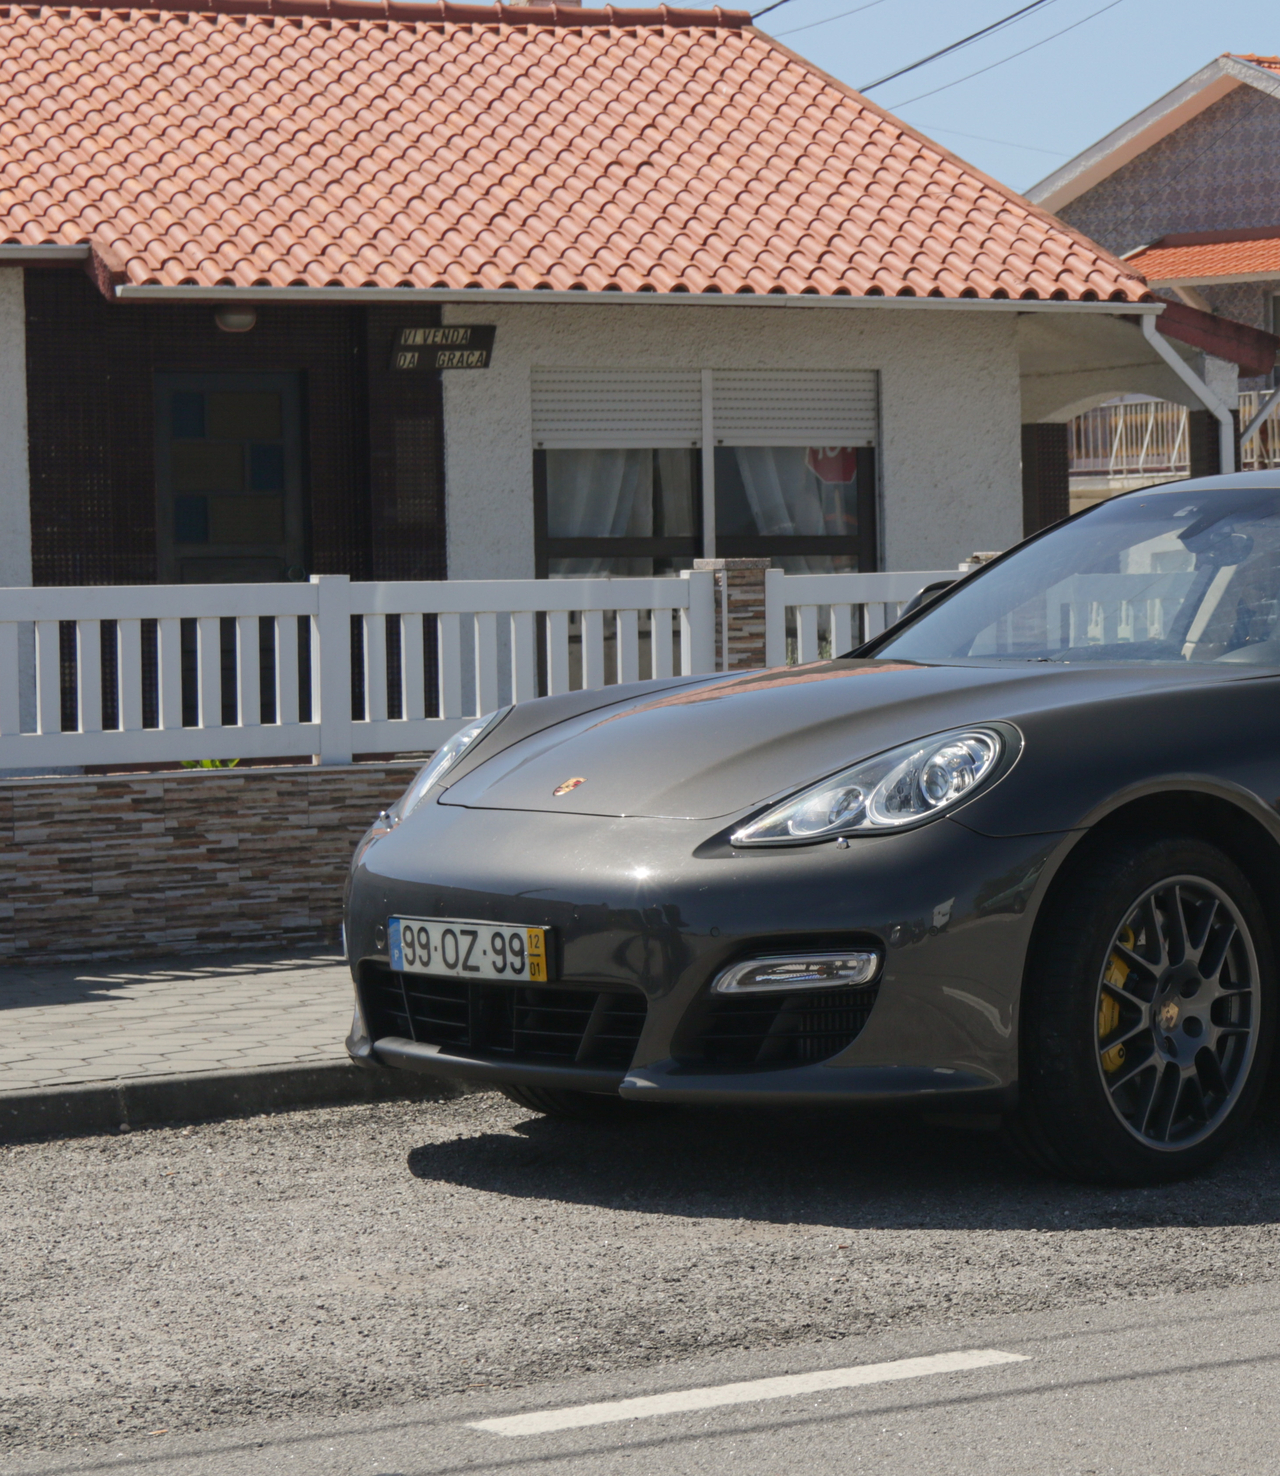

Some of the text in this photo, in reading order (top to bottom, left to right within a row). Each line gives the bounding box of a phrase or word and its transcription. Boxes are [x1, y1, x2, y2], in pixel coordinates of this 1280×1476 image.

[398, 352, 416, 368] DA
[528, 933, 540, 949] 12
[394, 949, 400, 961] P
[529, 961, 541, 977] 01
